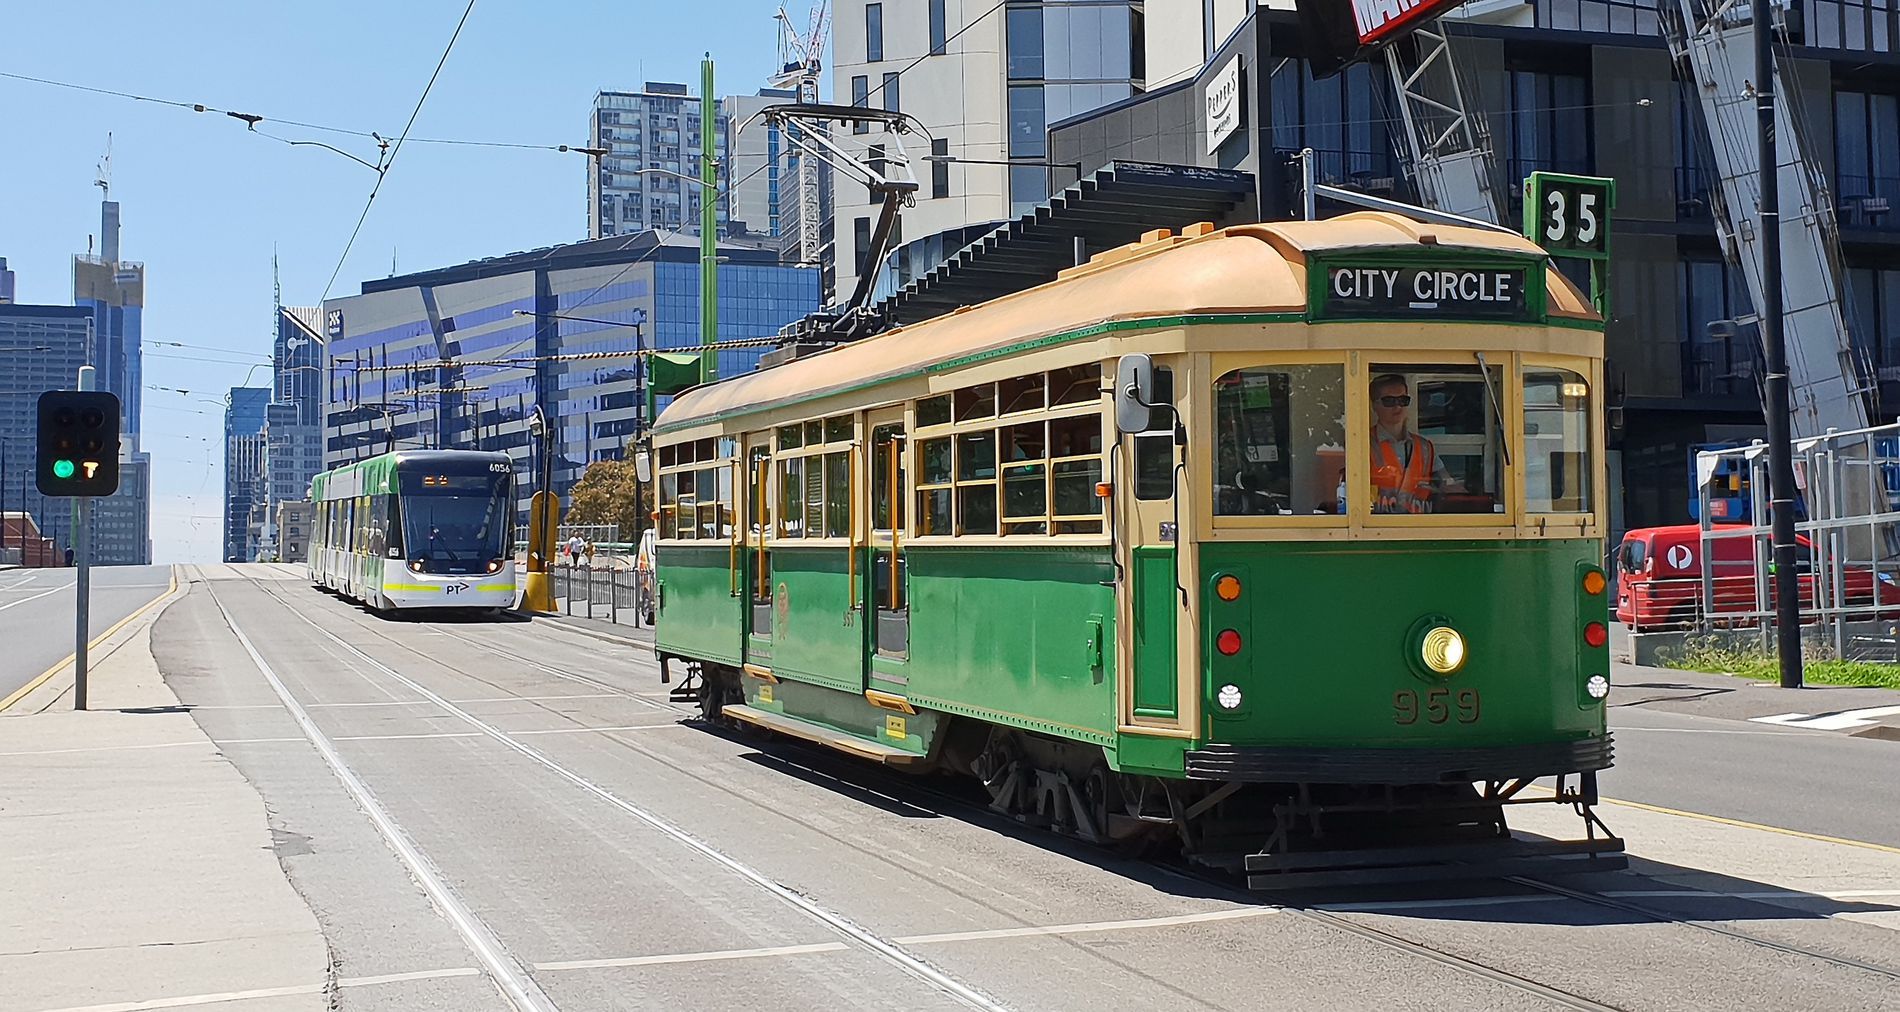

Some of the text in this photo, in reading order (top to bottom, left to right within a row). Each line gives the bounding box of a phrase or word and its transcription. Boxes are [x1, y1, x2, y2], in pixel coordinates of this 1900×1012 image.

[1334, 268, 1511, 301] CITY CIRCLE
[489, 463, 511, 473] 6056
[1393, 687, 1480, 725] 959
